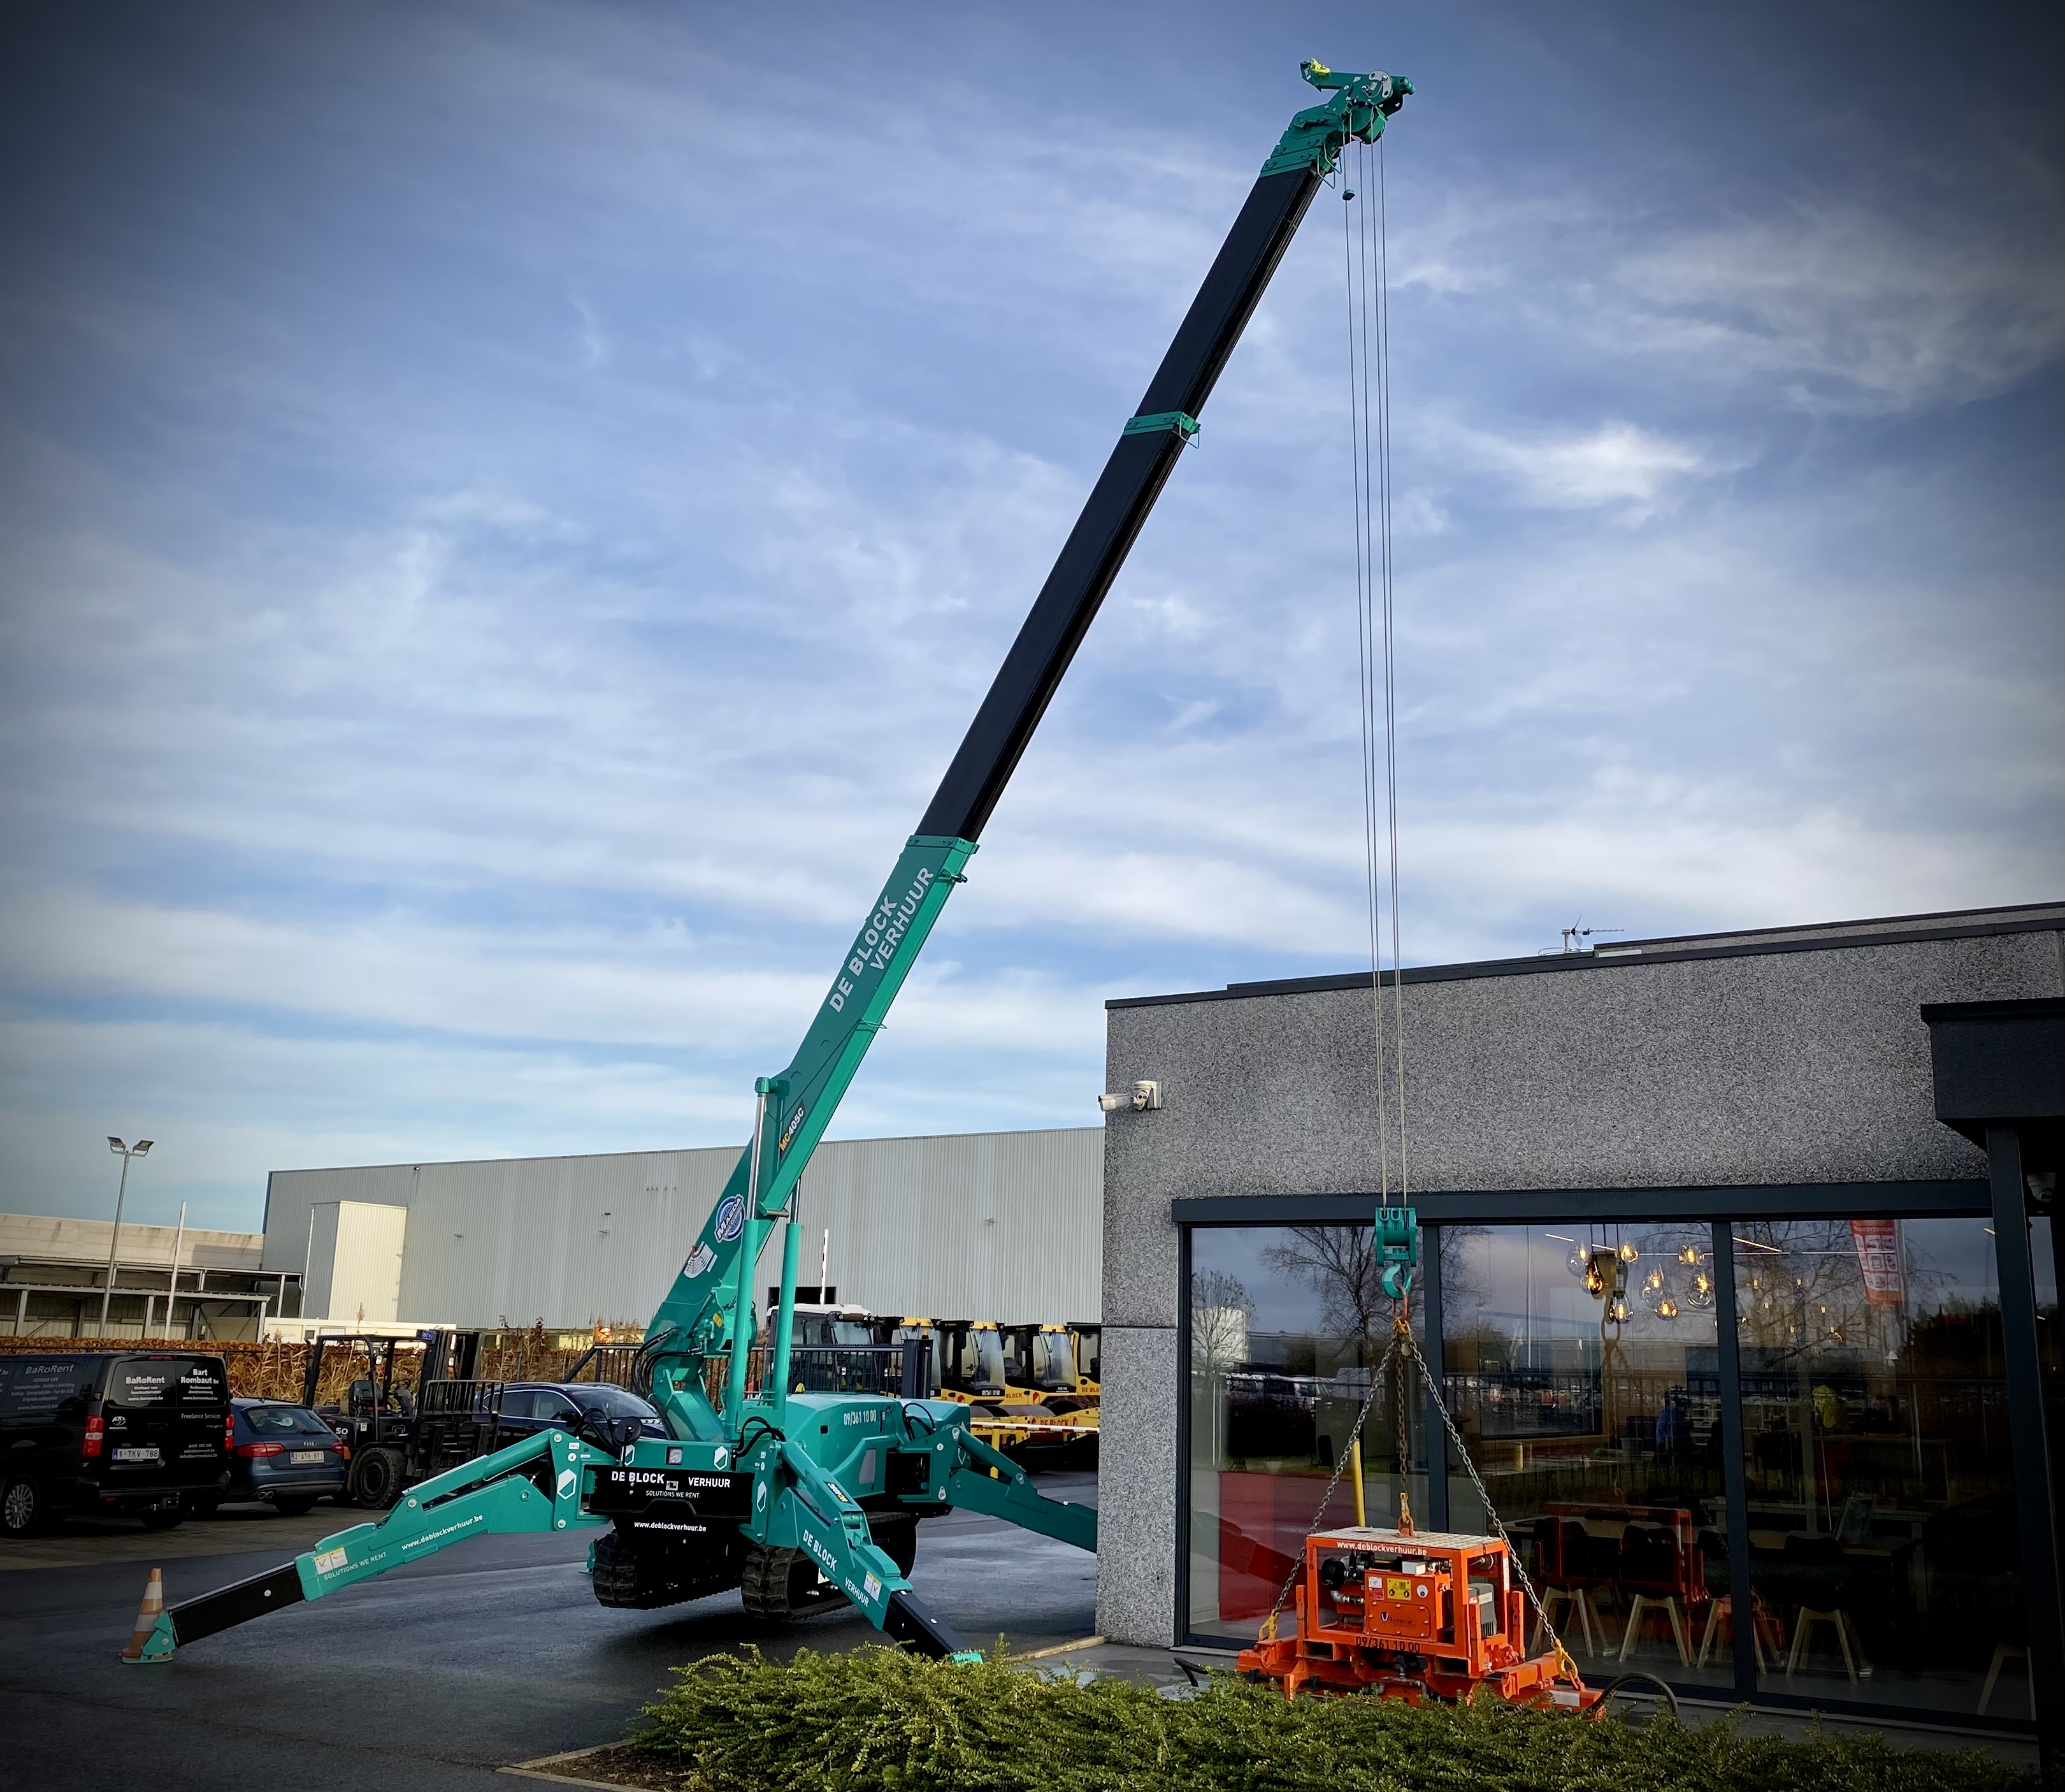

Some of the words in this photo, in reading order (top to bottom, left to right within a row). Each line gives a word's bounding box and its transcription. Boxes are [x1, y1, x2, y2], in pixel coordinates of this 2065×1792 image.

[870, 867, 934, 970] VERHUUR
[829, 976, 854, 1013] DE
[848, 895, 898, 977] BLOCK
[779, 1108, 804, 1152] MC405C
[25, 1364, 75, 1374] BaRoRent
[844, 1410, 861, 1426] 09/361
[863, 1410, 870, 1423] 10
[870, 1409, 877, 1422] 00
[335, 1427, 349, 1435] 50
[612, 1471, 626, 1482] DE
[629, 1472, 665, 1484] BLOCK
[688, 1477, 731, 1488] VERHUUR
[401, 1514, 484, 1550] www.deblockverhuur.be
[634, 1521, 707, 1532] www.deblockverhuur.be
[1337, 1541, 1427, 1556] www.deblockverhuur.be
[324, 1563, 359, 1581] SOLUTIONS
[359, 1558, 370, 1566] WE
[803, 1529, 813, 1547] DE
[813, 1541, 837, 1572] BLOCK
[845, 1577, 870, 1608] VERHUUR
[1356, 1636, 1390, 1650] 09/361
[1393, 1640, 1406, 1652] 10
[1408, 1642, 1421, 1653] 00
